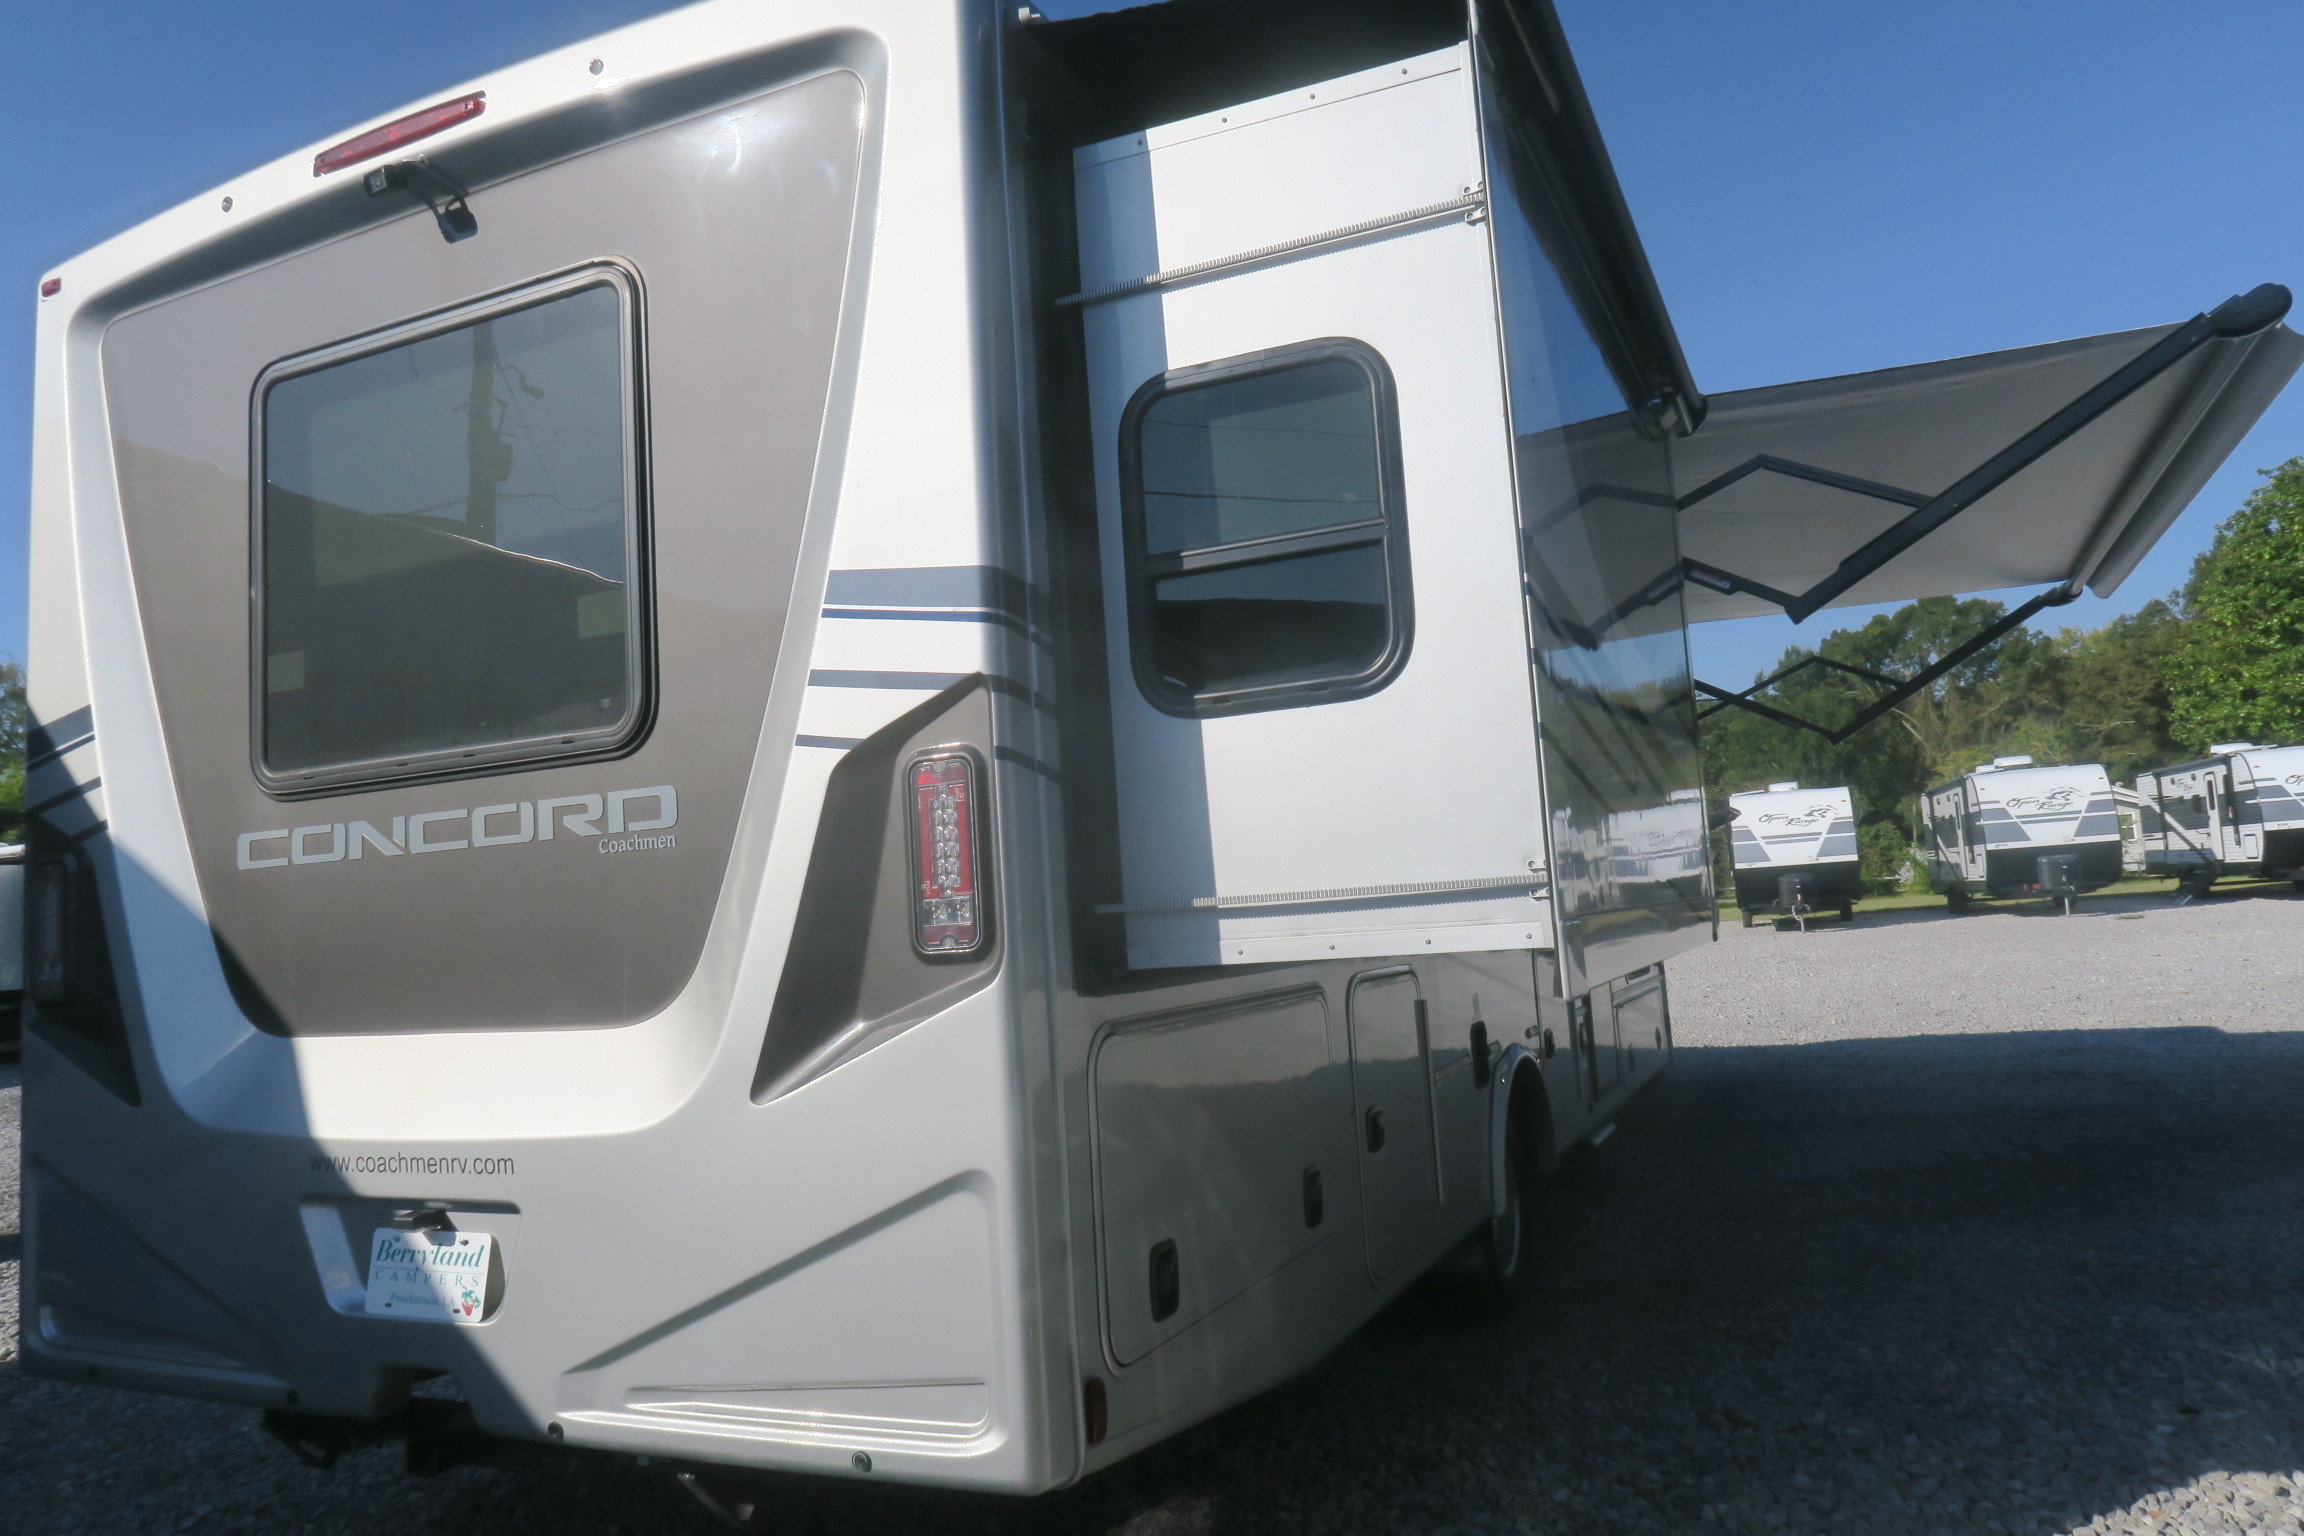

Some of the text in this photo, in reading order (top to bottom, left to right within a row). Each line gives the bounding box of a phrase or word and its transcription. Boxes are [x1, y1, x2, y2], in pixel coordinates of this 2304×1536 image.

[2006, 796, 2074, 812] Open Range
[237, 784, 679, 870] CONCORD
[1758, 813, 1819, 828] Open Range
[599, 832, 677, 854] Coachmen
[310, 1151, 515, 1175] www.coachmenrv.com
[375, 1239, 485, 1268] Berryland
[375, 1269, 480, 1288] CAMPERS
